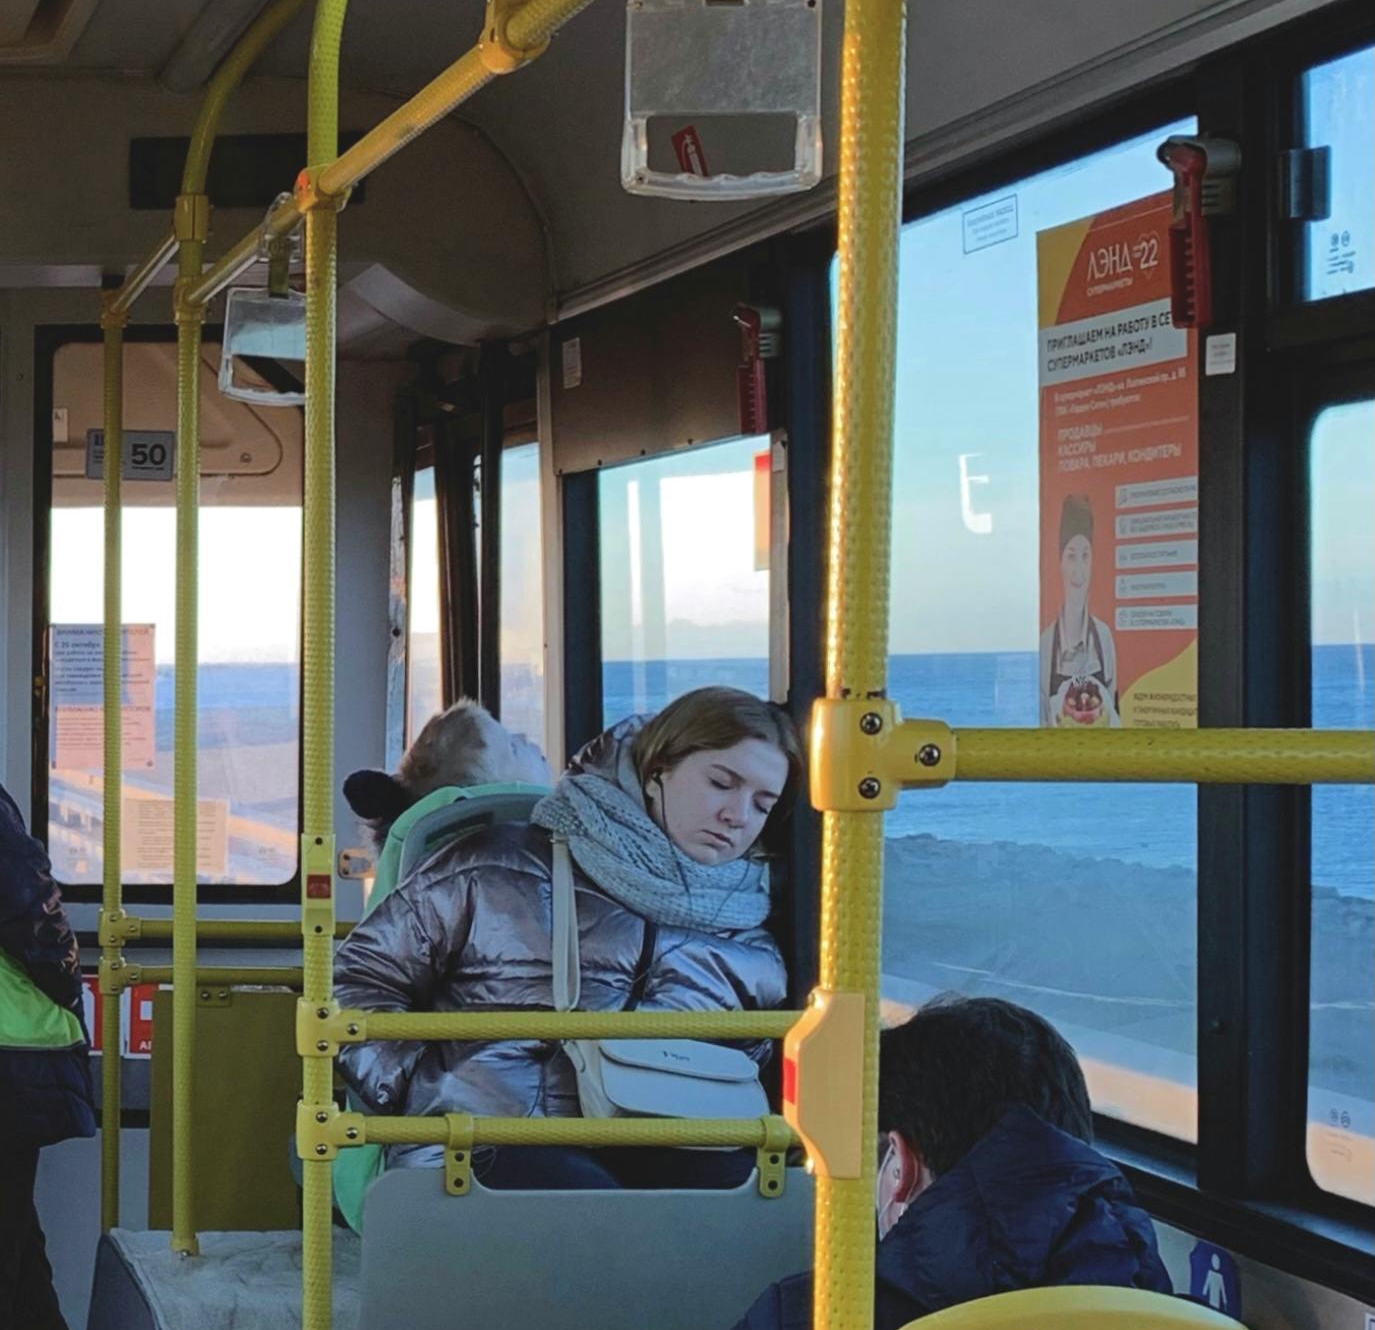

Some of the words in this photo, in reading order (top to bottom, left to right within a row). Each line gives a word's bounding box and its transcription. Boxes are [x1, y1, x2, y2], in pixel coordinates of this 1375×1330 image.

[1087, 242, 1133, 281] ЛЭНД
[1140, 238, 1158, 269] 22
[1047, 330, 1104, 352] ПРИГЛАШАЕМ
[1104, 325, 1116, 338] НА
[1117, 317, 1150, 337] РАБОТУ
[1151, 314, 1157, 328] В
[1158, 311, 1172, 326] СЕ
[1047, 345, 1117, 372] СУПЕРМАРКЕТОВ
[131, 443, 167, 466] 50
